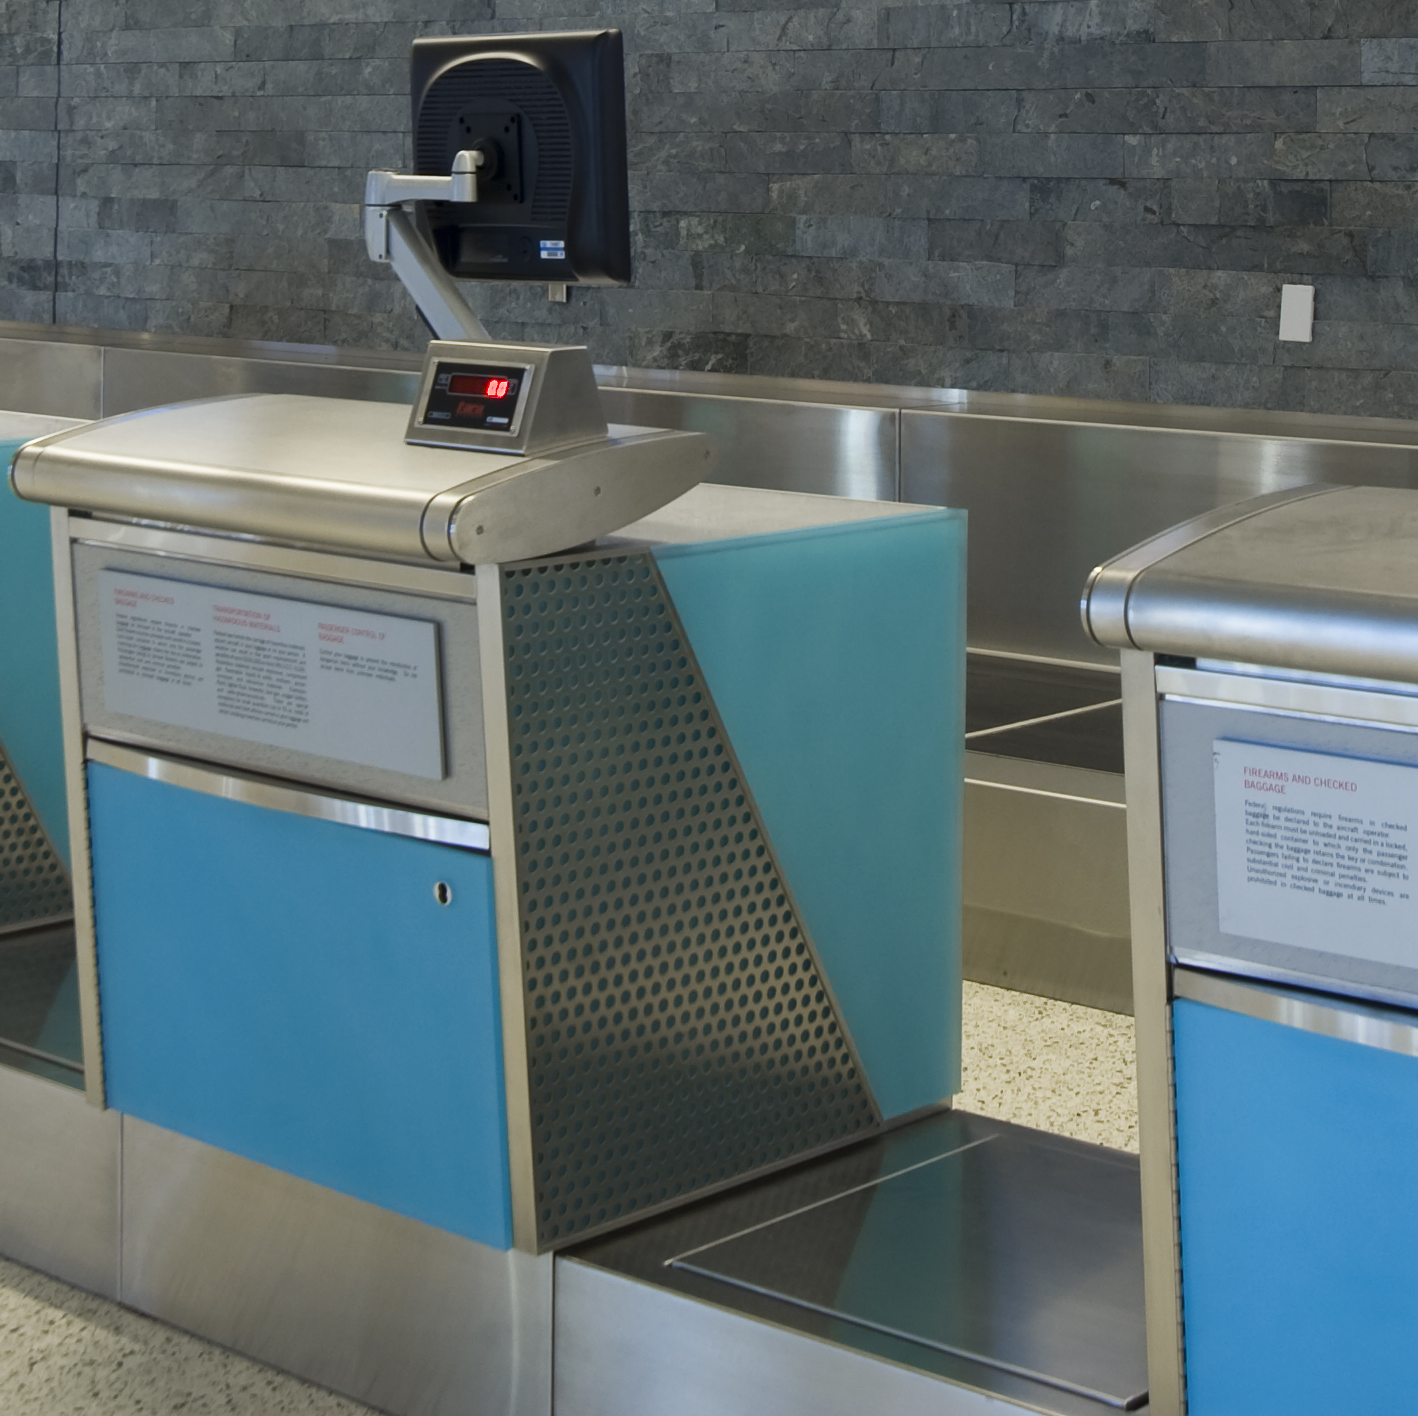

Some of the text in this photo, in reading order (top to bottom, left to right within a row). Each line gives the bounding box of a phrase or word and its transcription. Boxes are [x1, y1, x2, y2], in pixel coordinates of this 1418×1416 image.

[1243, 766, 1358, 793] FIREARMS AND CHECKED
[1243, 779, 1286, 795] BAGGAGE
